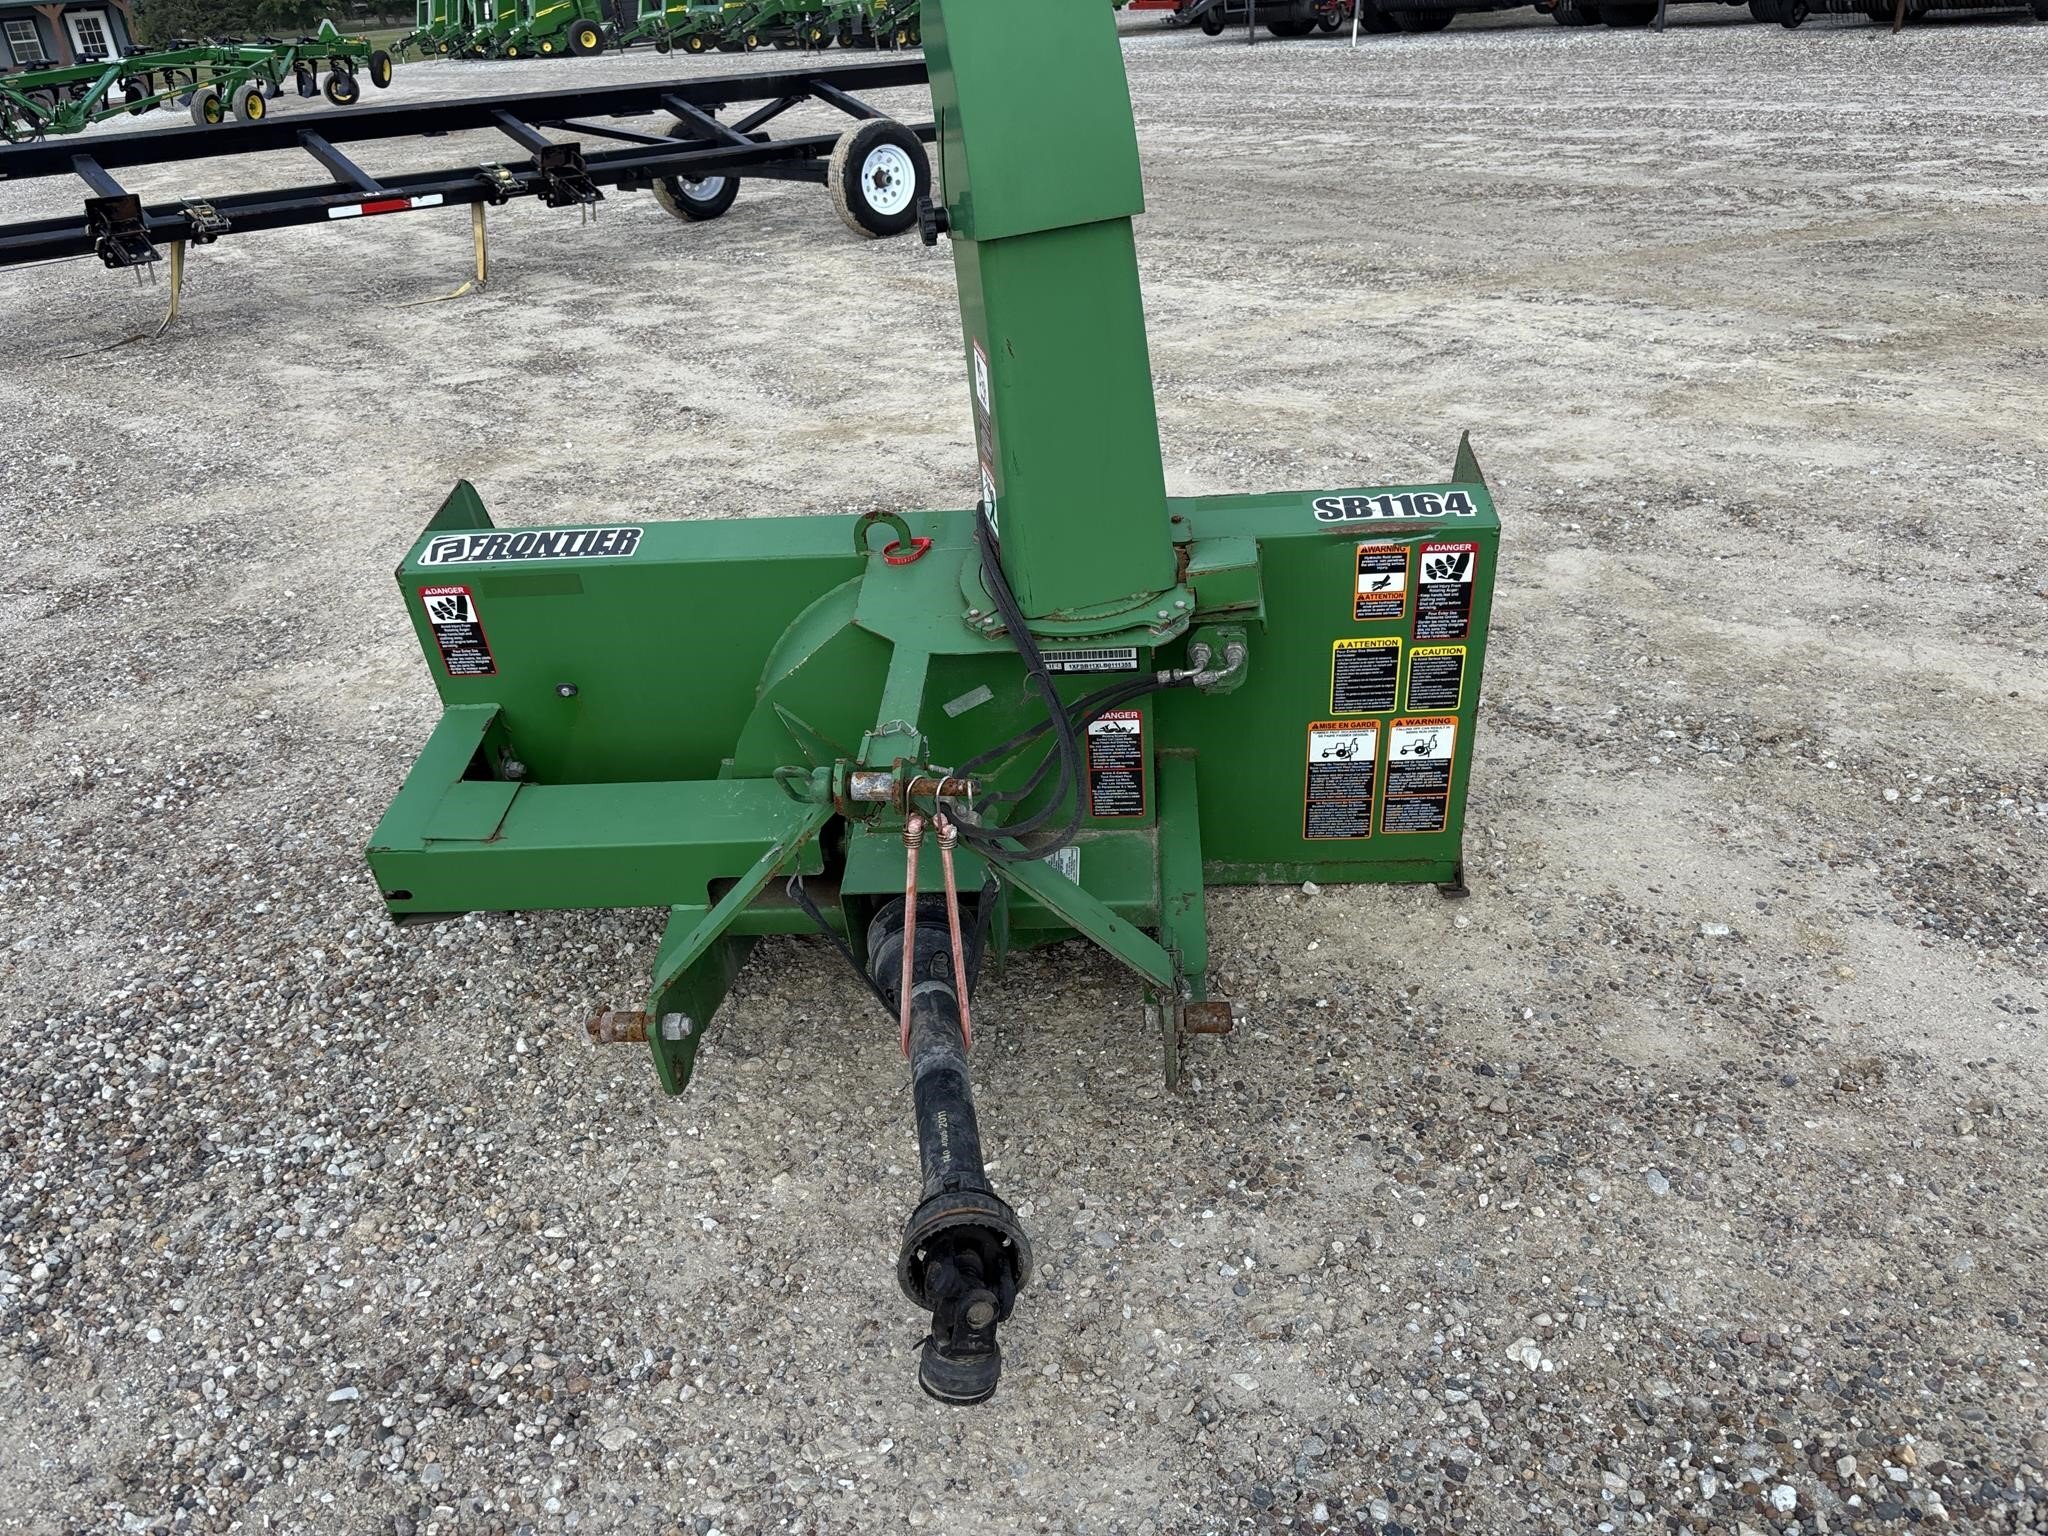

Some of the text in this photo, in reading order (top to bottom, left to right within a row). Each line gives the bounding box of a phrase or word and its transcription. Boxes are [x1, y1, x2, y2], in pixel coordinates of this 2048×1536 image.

[1314, 492, 1474, 521] SB1164
[468, 529, 641, 558] FRONTIER
[1434, 543, 1472, 552] DANGER
[1368, 545, 1406, 553] WARNING
[430, 587, 465, 595] DANGER
[1347, 640, 1398, 648] ATTENTION
[1422, 648, 1463, 656] CAUTION
